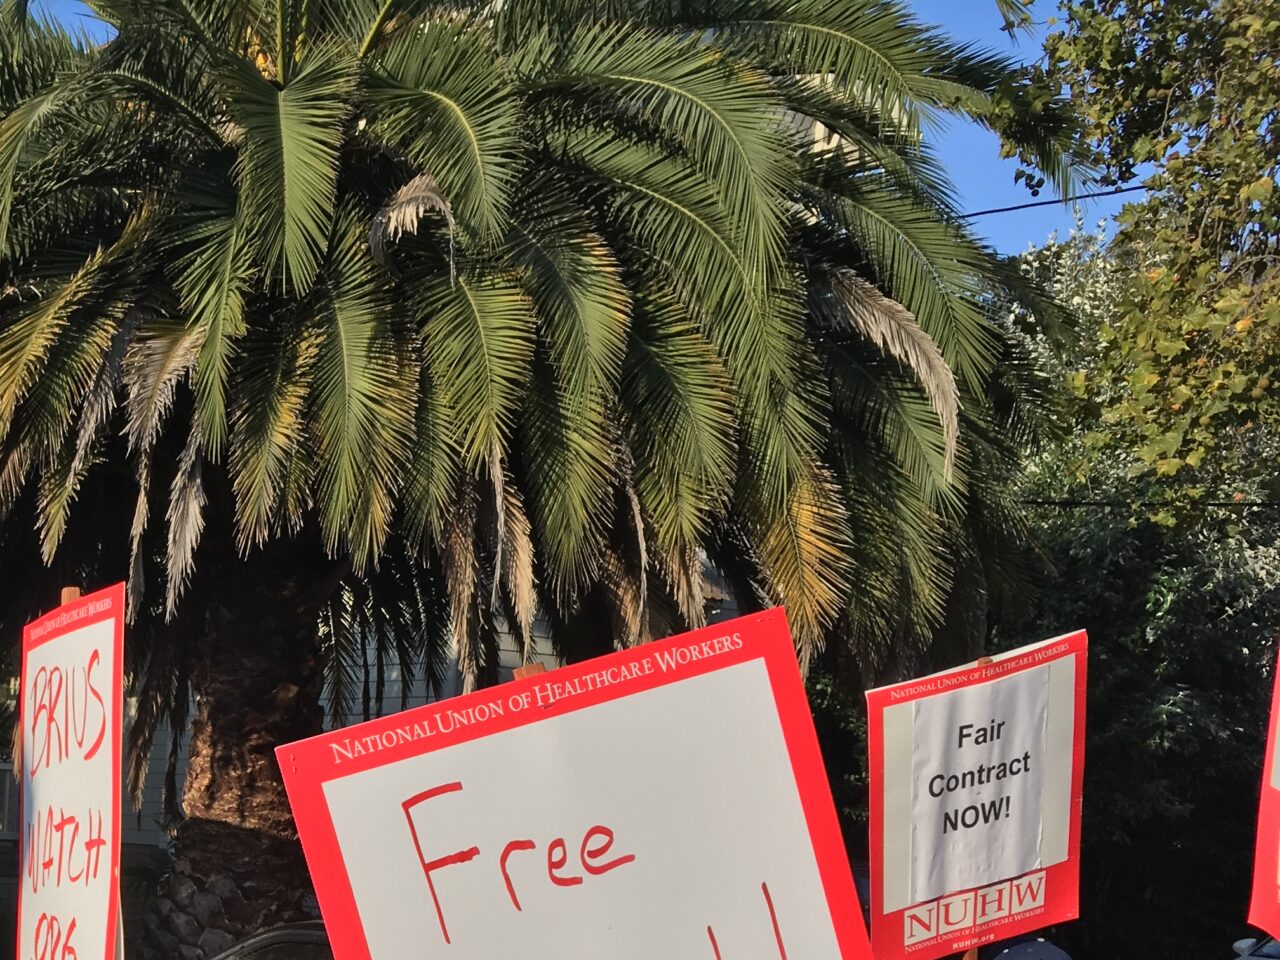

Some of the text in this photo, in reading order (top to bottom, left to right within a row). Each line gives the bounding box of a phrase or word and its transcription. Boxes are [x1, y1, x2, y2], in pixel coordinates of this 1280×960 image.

[329, 632, 744, 764] NATIONAL UNION OF HEALTHCARE WORKERS
[890, 643, 1070, 700] NATIONAL UNION OF HEALTHCARE WORKERS
[31, 648, 107, 784] BRIUS
[957, 718, 1005, 749] Fair
[928, 751, 1030, 798] Contract
[942, 795, 1011, 834] NOW!
[28, 805, 107, 894] WATCH
[401, 781, 636, 945] Free
[906, 876, 1044, 939] NUHW
